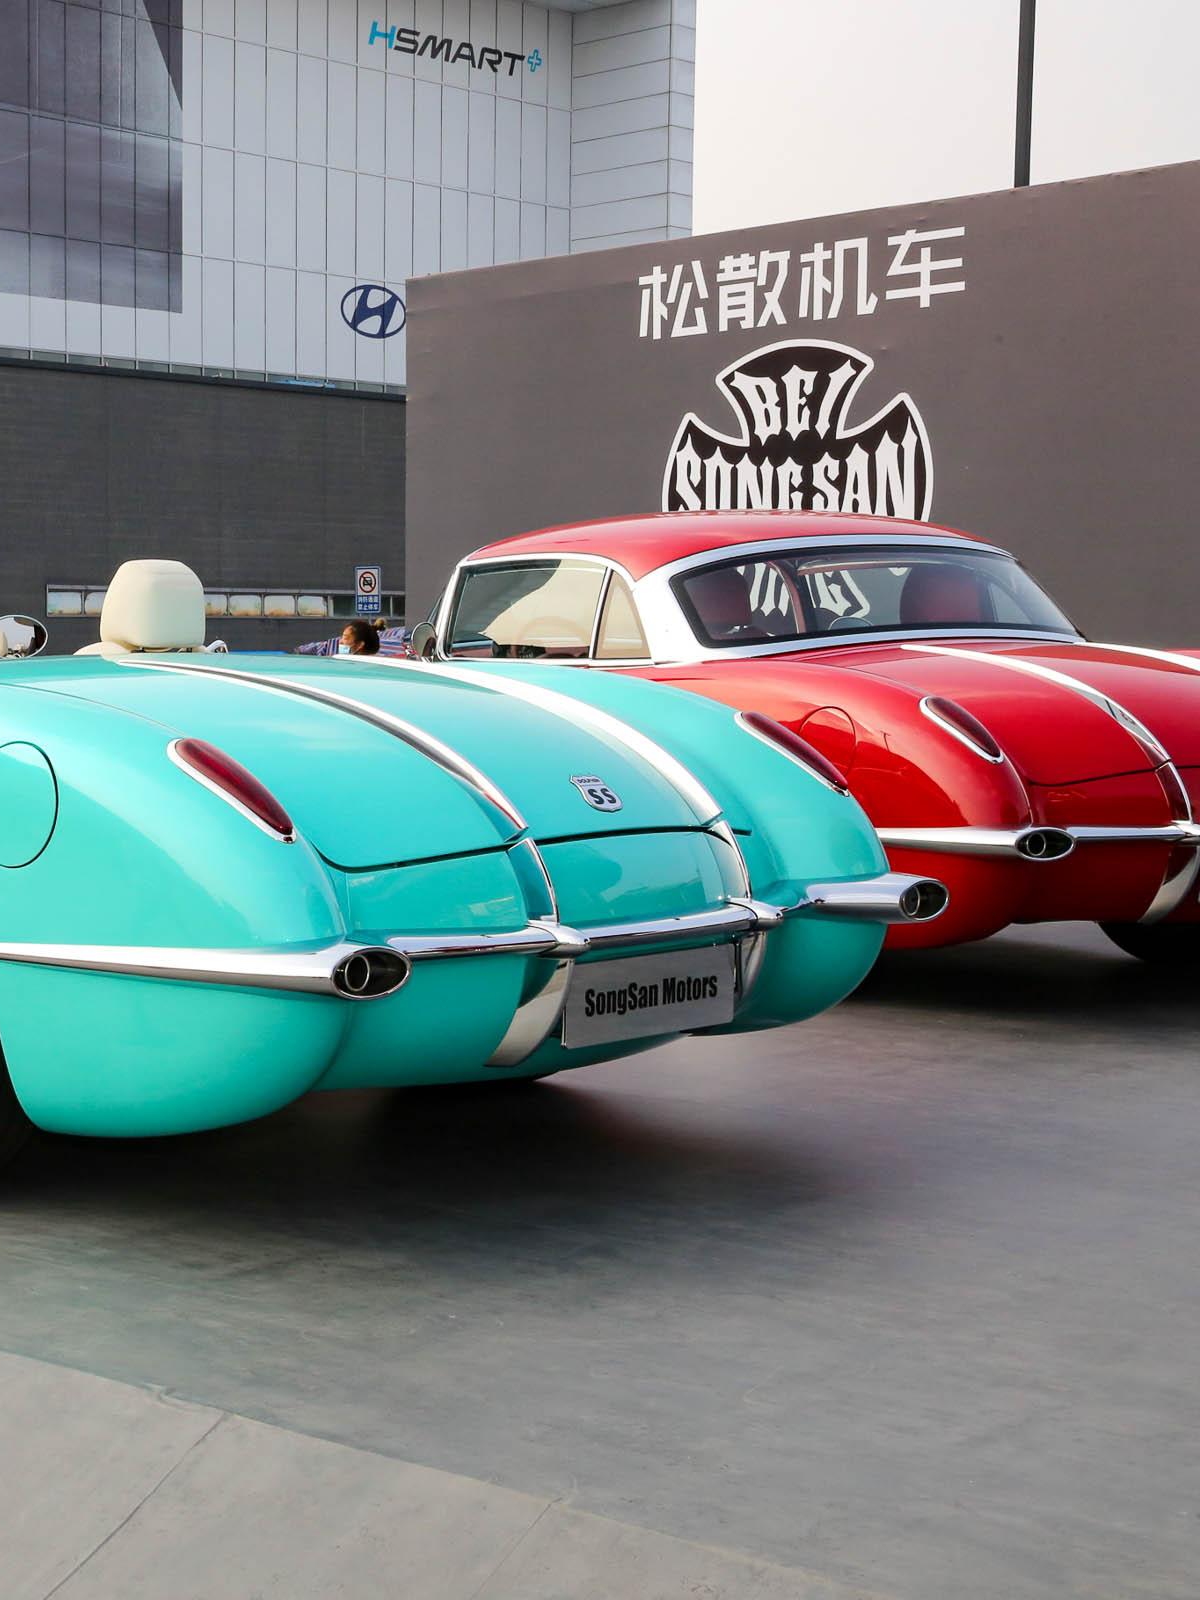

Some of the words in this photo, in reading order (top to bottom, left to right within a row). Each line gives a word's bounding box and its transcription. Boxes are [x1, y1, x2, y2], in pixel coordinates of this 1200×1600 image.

[638, 226, 965, 340] 松散机车
[730, 360, 856, 446] BEI
[587, 788, 617, 805] SS
[584, 982, 658, 1017] SongSan
[662, 975, 718, 1005] Motors
